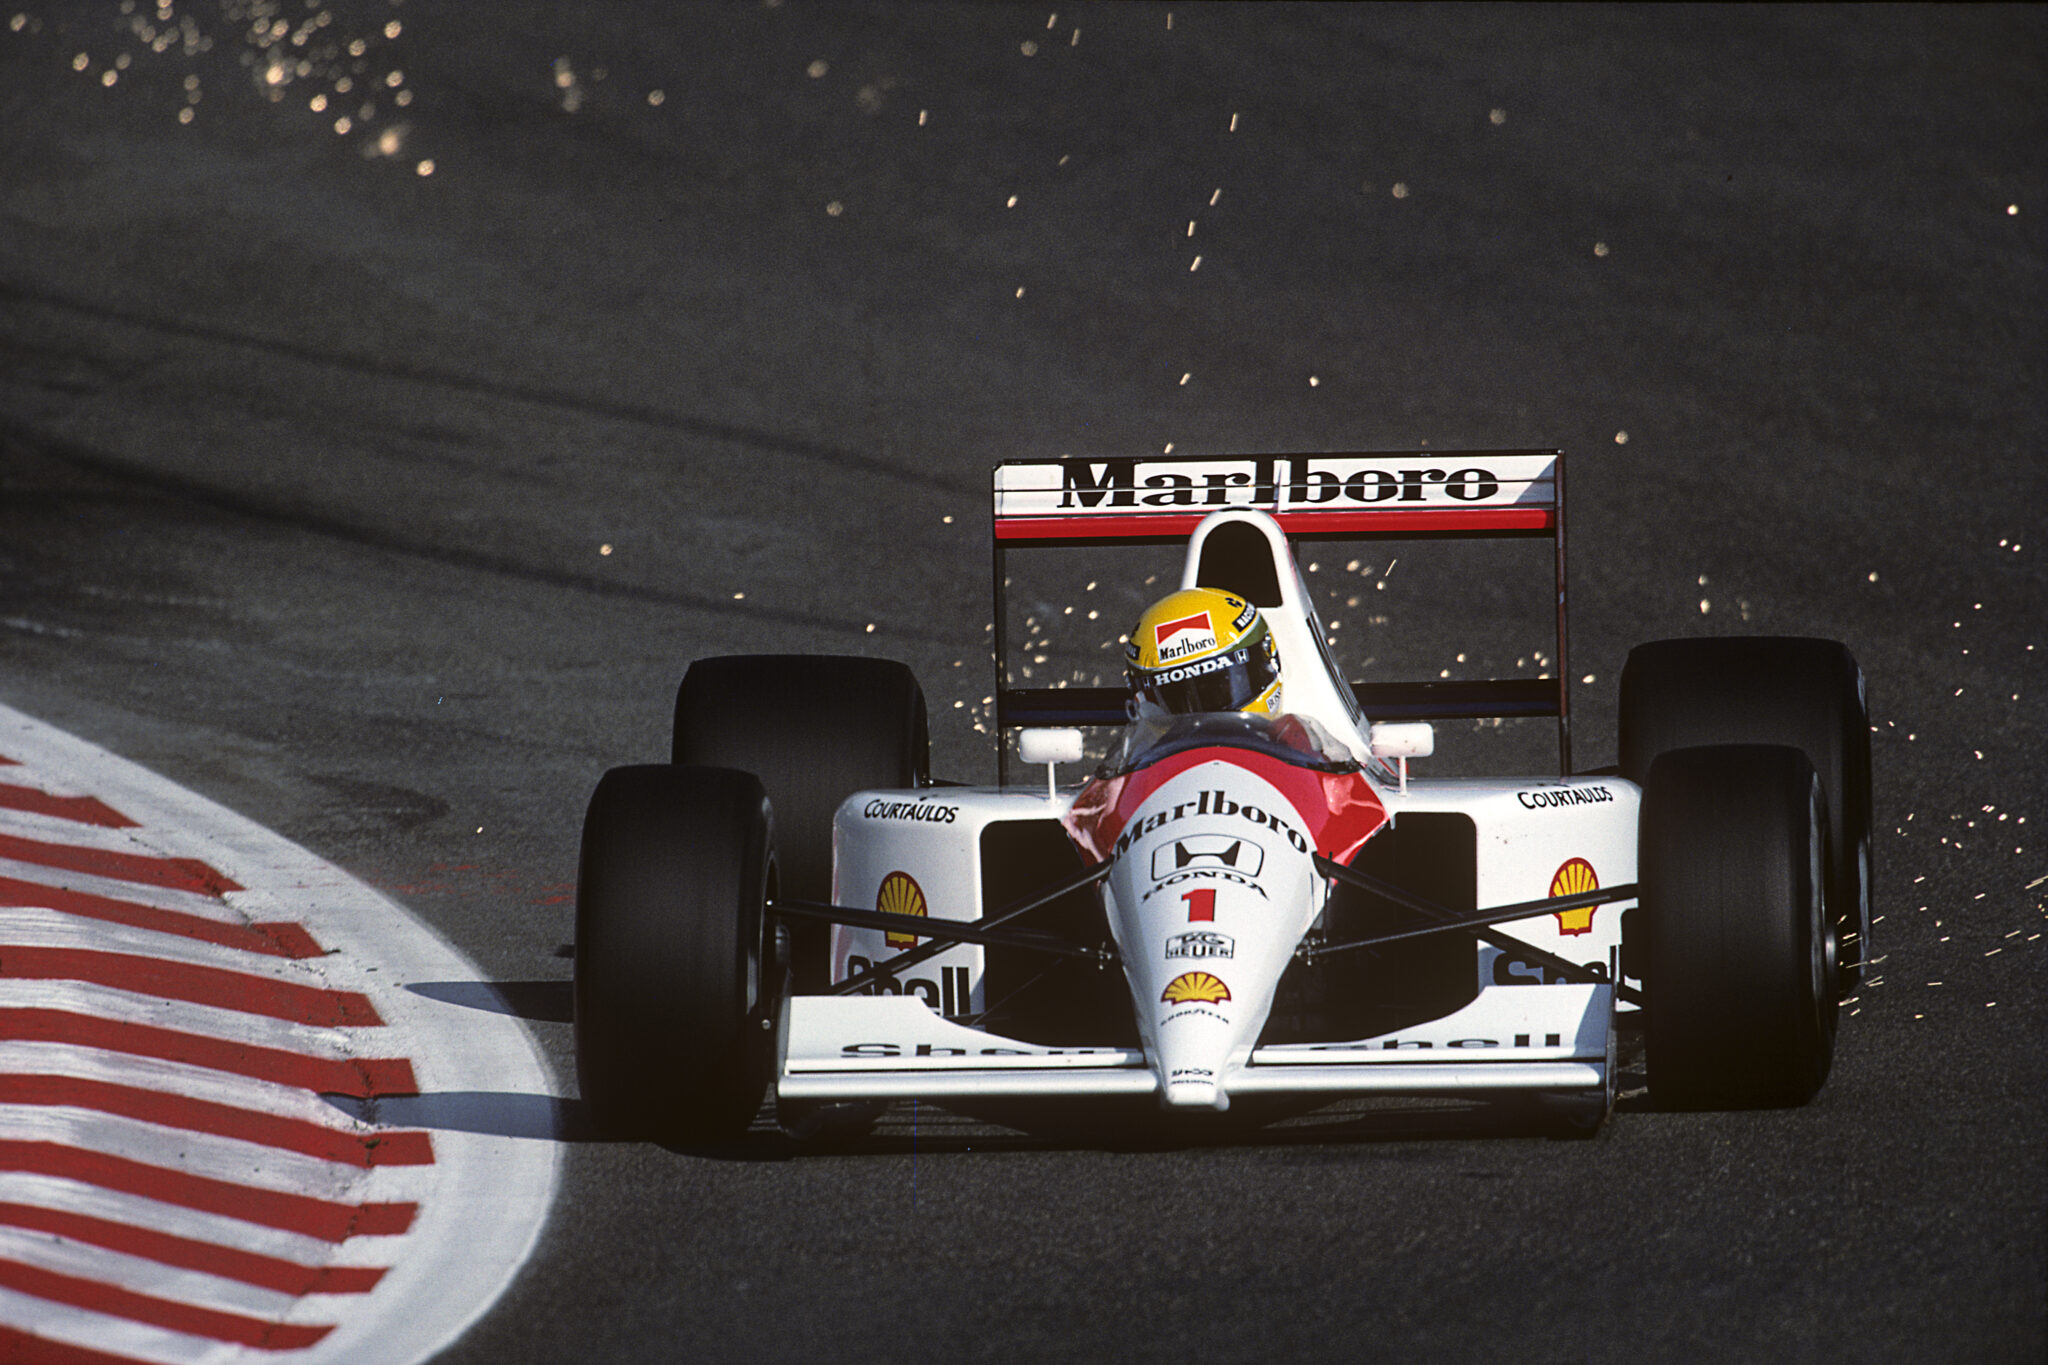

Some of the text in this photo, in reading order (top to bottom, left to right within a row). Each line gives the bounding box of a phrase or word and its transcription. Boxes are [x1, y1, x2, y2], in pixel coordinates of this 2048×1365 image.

[1056, 458, 1499, 508] Marlboro
[1159, 637, 1216, 661] Marlboro
[1154, 655, 1234, 687] HONDA
[864, 799, 959, 824] COURTAULDS
[1517, 786, 1614, 810] COURTAULDS
[1115, 790, 1308, 863] Marlboro
[1141, 871, 1270, 903] HONDA
[1181, 888, 1216, 923] 1
